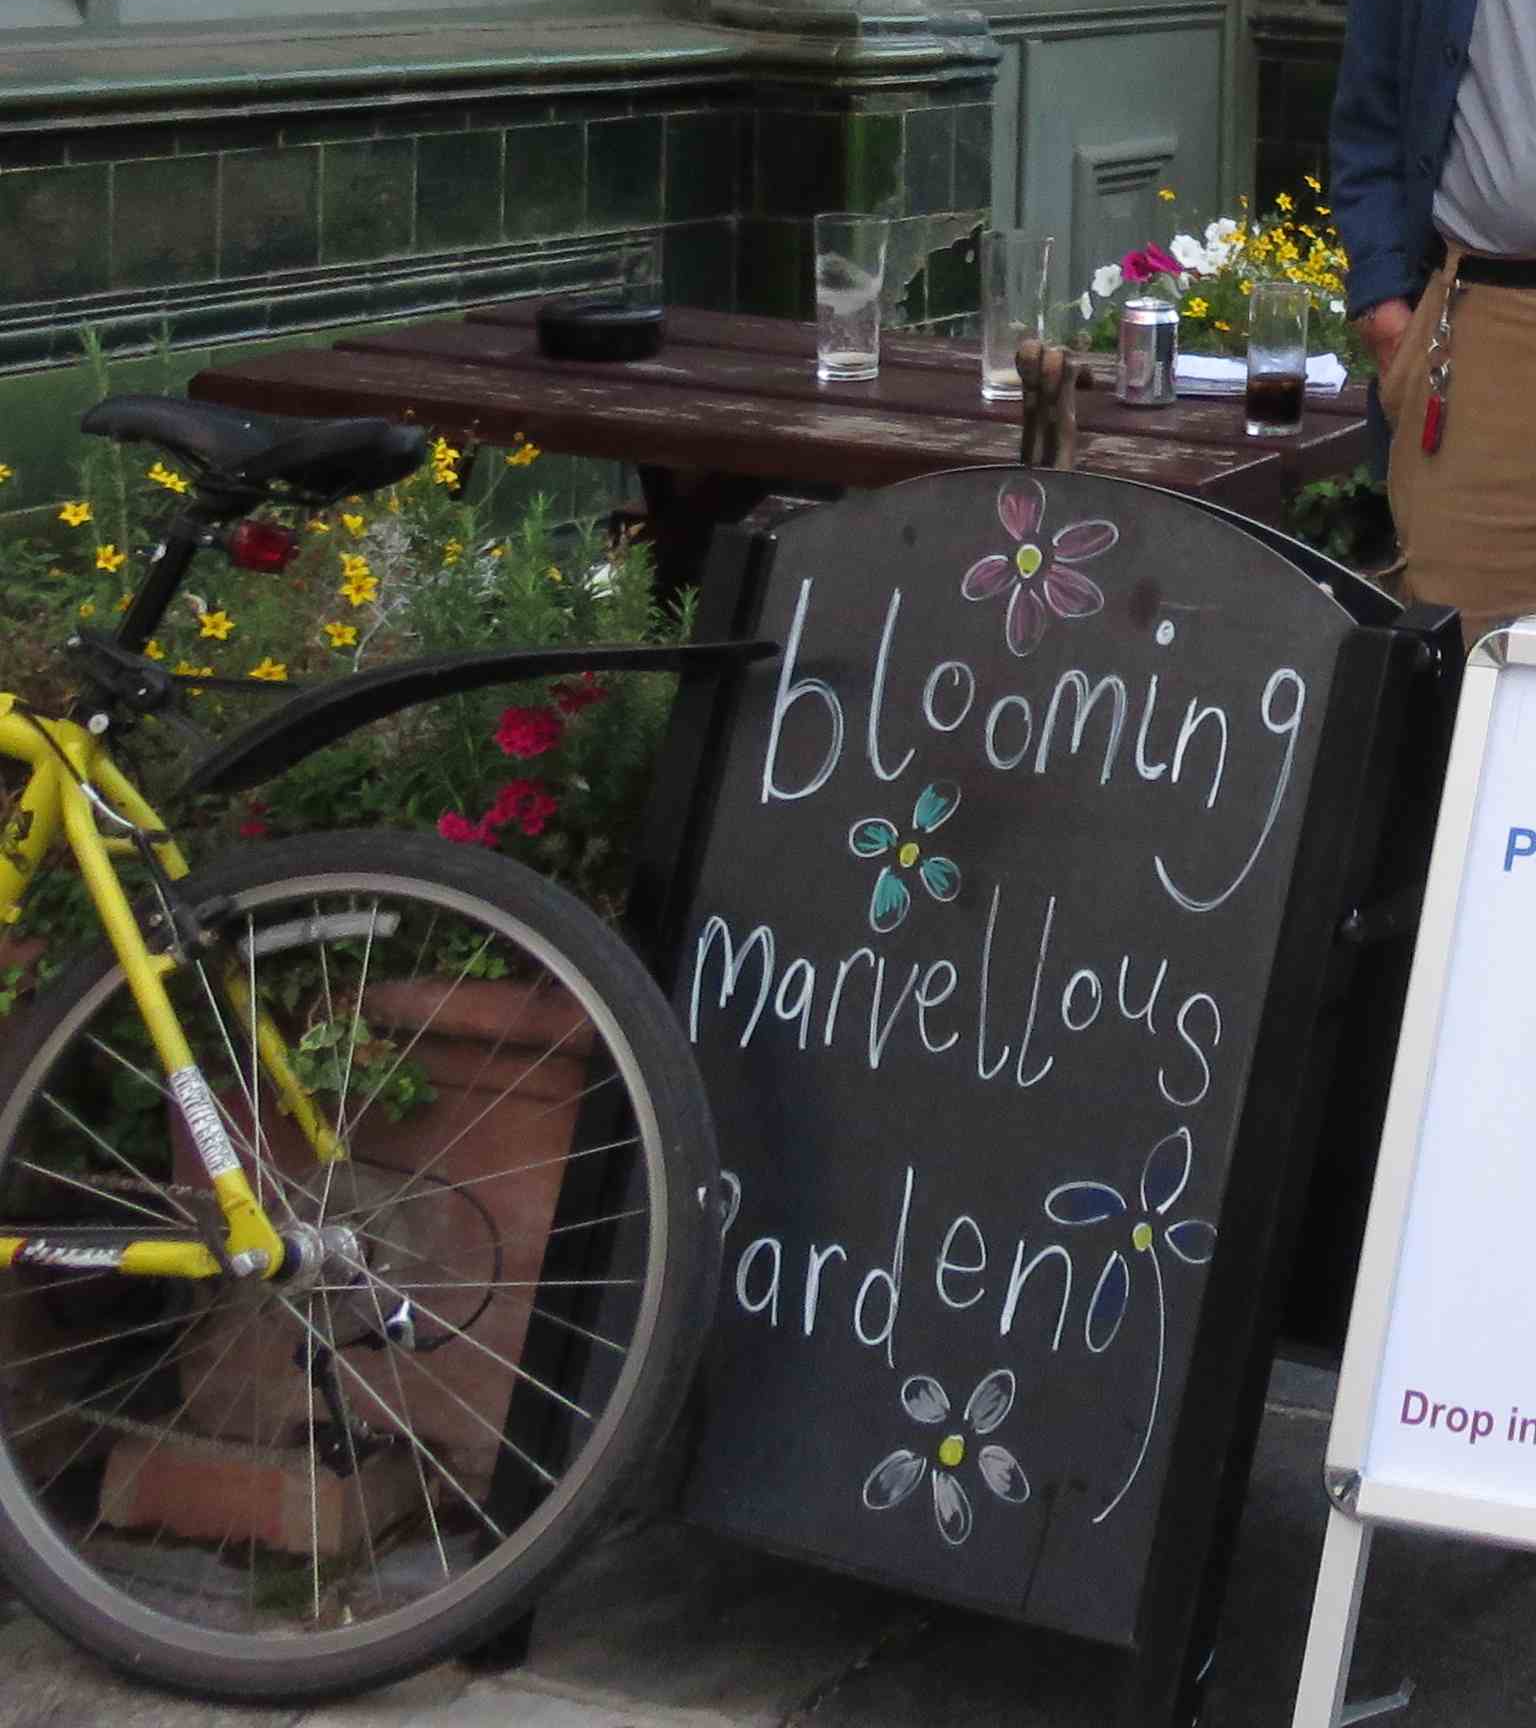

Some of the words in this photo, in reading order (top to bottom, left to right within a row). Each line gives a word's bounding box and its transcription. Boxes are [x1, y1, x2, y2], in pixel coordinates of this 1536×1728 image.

[760, 575, 1307, 912] blooming
[689, 884, 1222, 1107] marvellous
[1400, 1389, 1495, 1445] Drop
